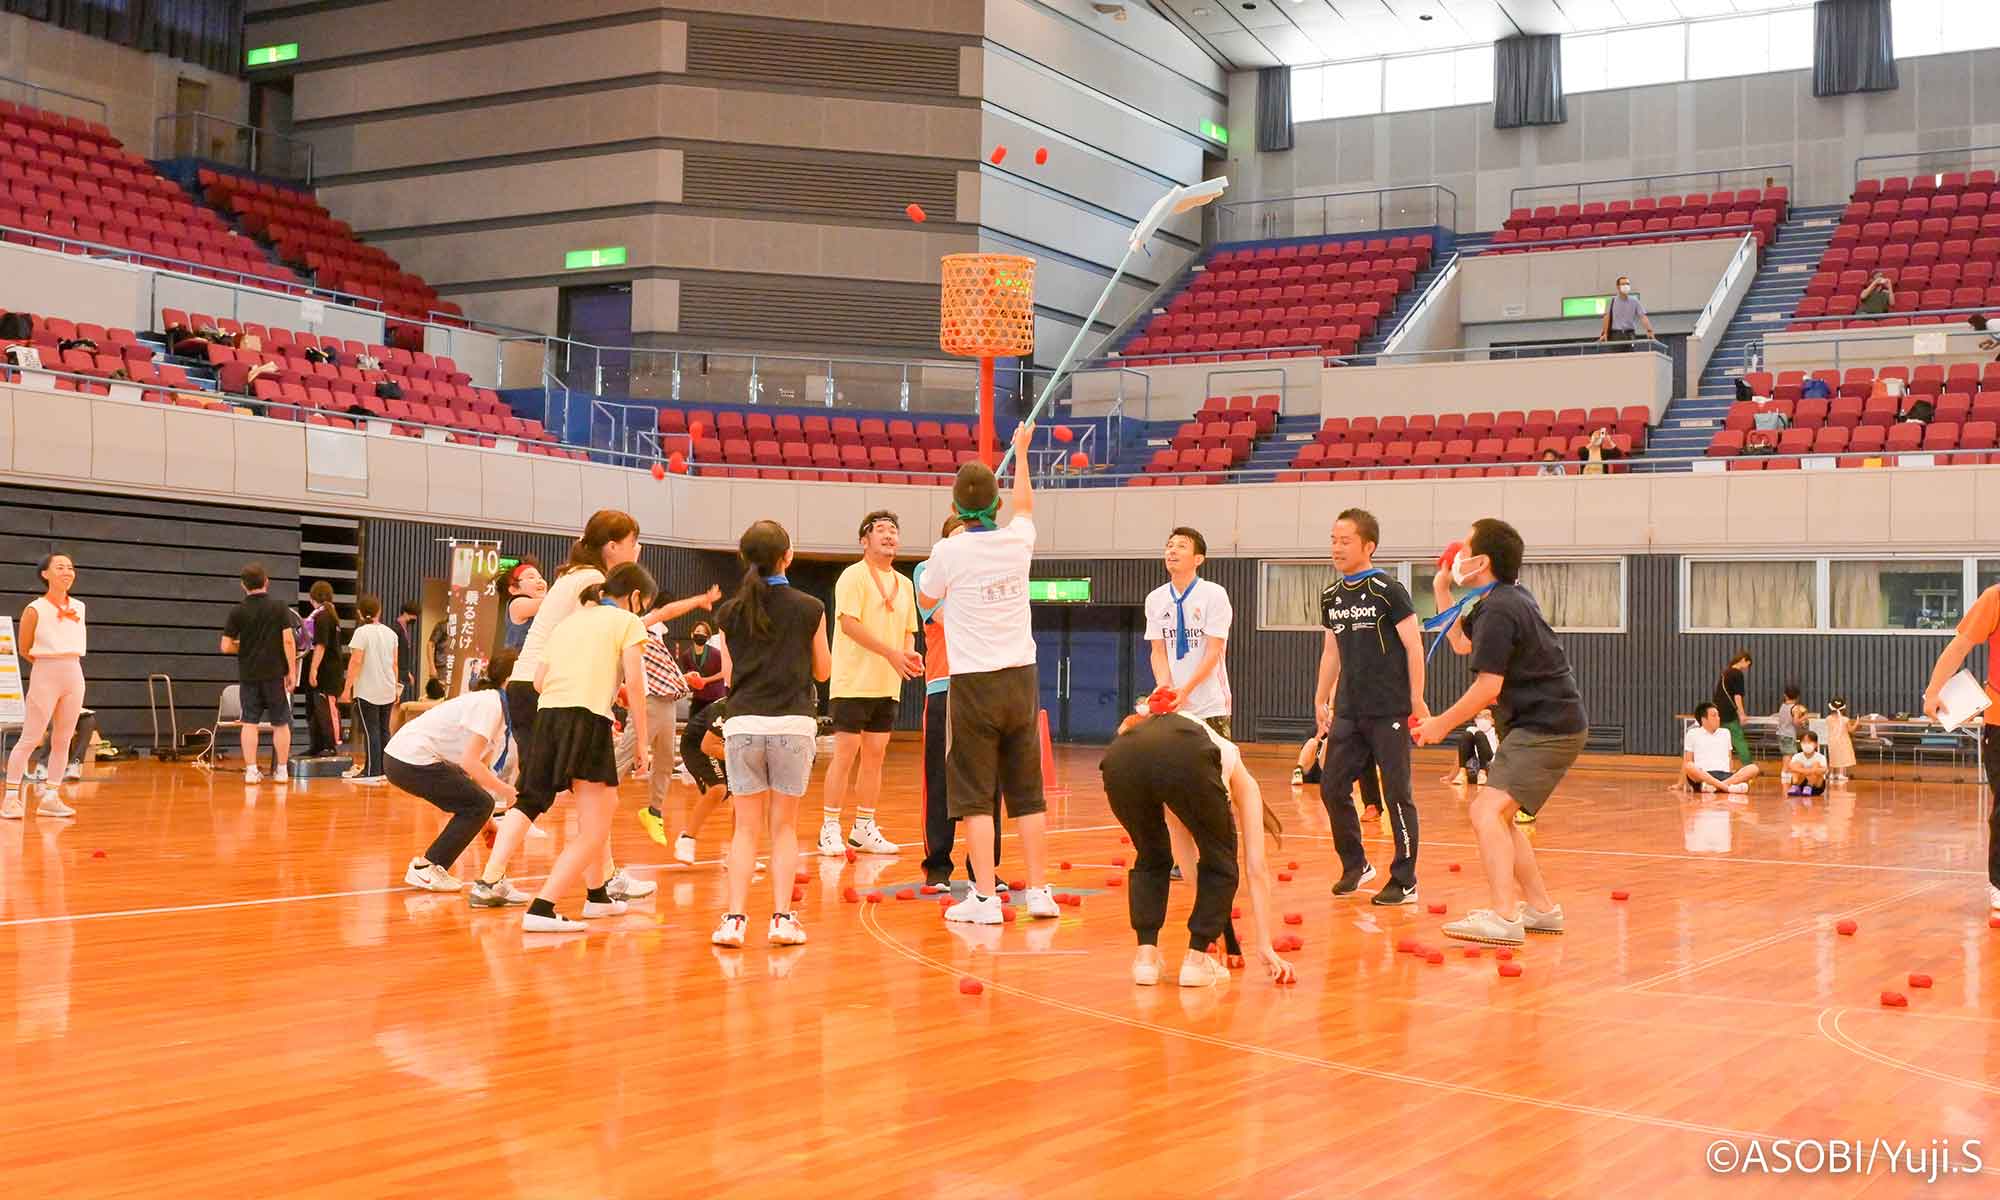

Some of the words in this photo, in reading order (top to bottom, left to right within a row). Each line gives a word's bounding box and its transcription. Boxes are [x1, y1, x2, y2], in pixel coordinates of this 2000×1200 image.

[460, 590, 480, 649] 乗るだけ
[1350, 605, 1377, 620] Sport
[1162, 627, 1205, 639] Emates
